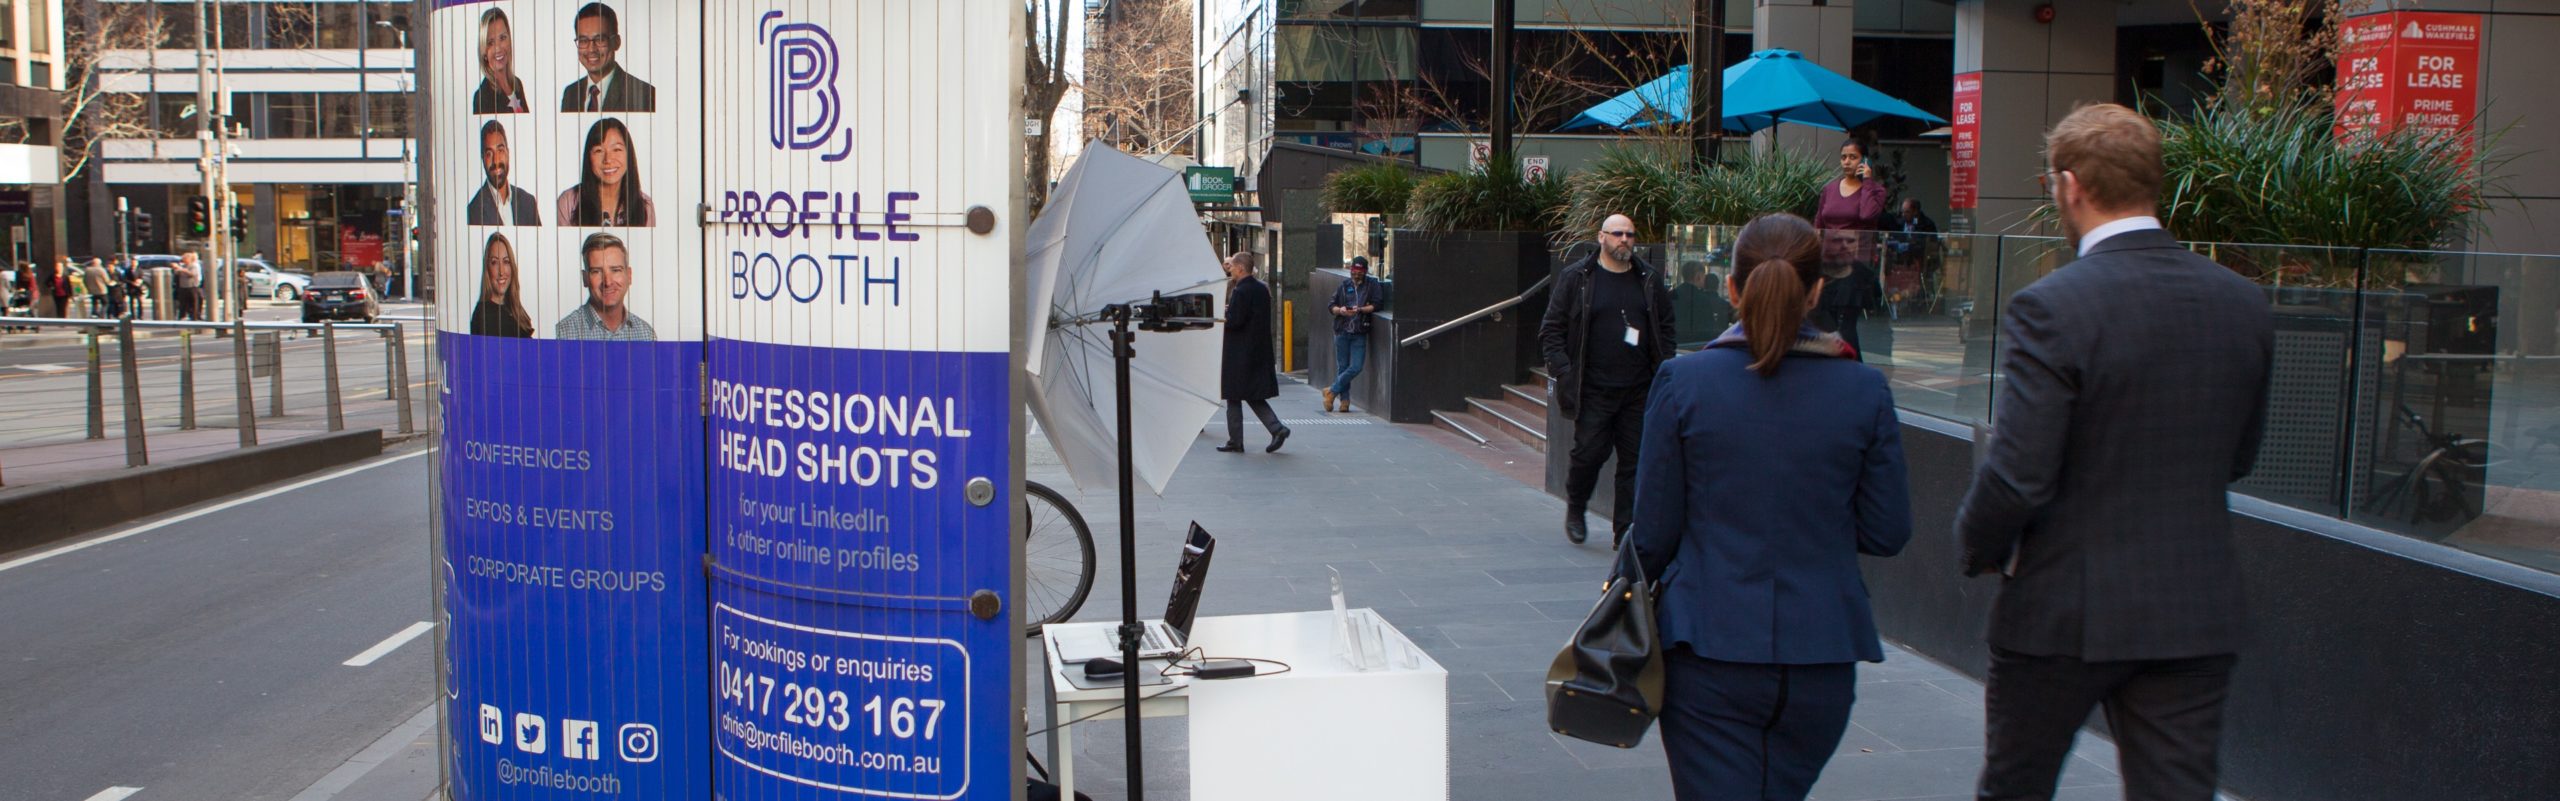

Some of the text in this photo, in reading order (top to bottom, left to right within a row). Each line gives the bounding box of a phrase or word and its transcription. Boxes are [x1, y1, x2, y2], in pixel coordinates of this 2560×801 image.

[2425, 24, 2468, 32] CUSHMAN
[2425, 32, 2476, 40] WAKEFIELD
[2351, 57, 2378, 73] FOR
[2407, 72, 2463, 89] LEASE
[2418, 56, 2455, 71] FOR
[1956, 114, 1975, 125] LEASE
[1960, 102, 1973, 113] FOR
[2406, 112, 2460, 125] BOURKE
[2414, 99, 2454, 111] PRIME
[1202, 183, 1232, 191] GROCER
[721, 191, 920, 242] PROFILE
[732, 251, 900, 307] BOOTH
[712, 377, 972, 438] PROFESSIONAL
[465, 440, 591, 471] CONFERENCES
[720, 428, 938, 490] HEAD SHOTS
[466, 497, 614, 532] EXPOS & EVENTS
[739, 492, 889, 534] for your LinkedIn
[727, 524, 920, 573] & other online profiles
[468, 554, 564, 588] CORPORATE
[570, 568, 666, 593] GROUPS
[723, 625, 933, 684] For bookings or enquiries
[720, 660, 946, 740] 0417 293 167
[722, 711, 941, 774] chris@profilebooth.com.au
[497, 757, 622, 794] @profilebooth
